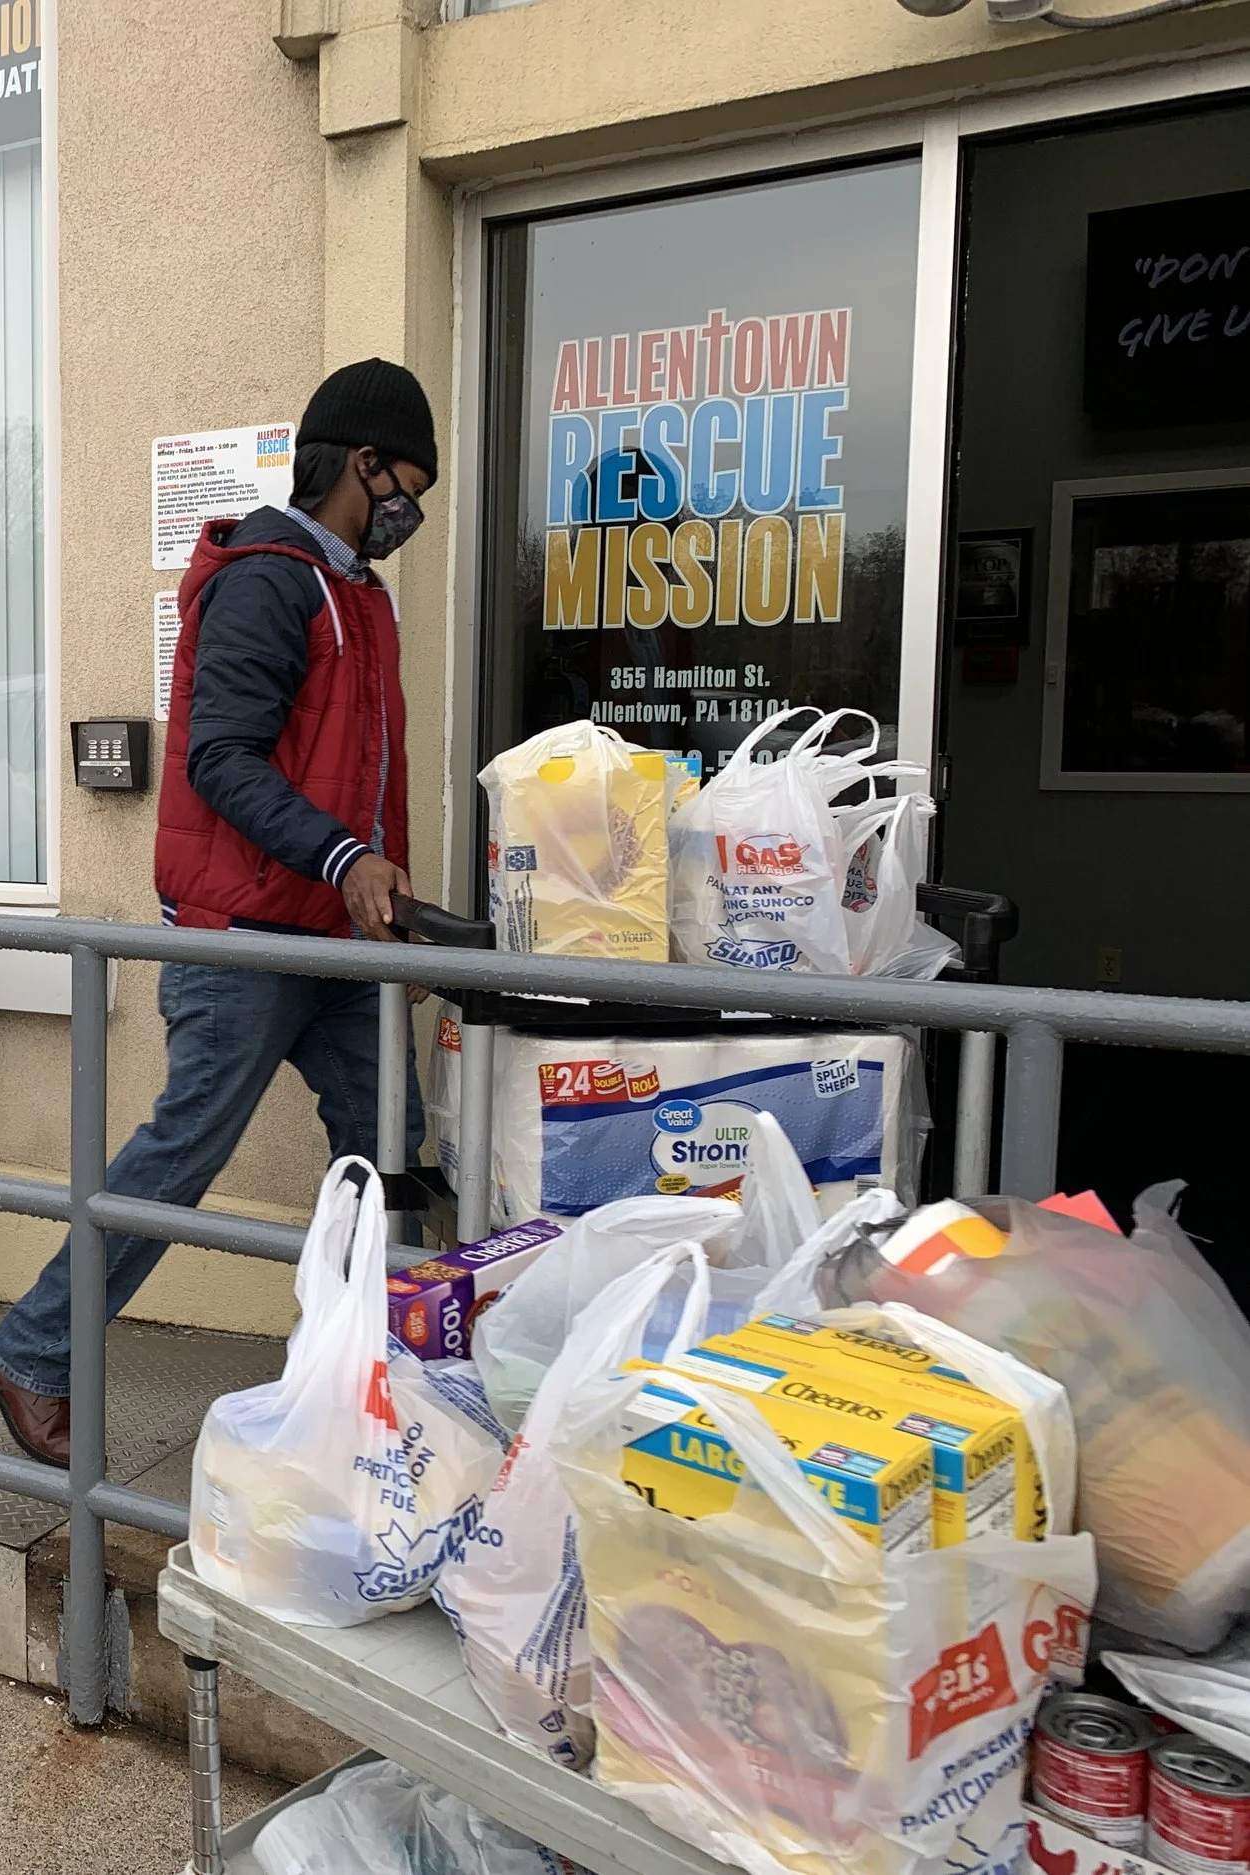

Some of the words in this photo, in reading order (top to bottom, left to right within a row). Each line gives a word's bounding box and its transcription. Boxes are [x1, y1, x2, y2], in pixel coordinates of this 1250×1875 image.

[1118, 308, 1212, 357] GIVE
[257, 438, 290, 454] RESCUE
[546, 388, 849, 526] RESCUE
[257, 453, 289, 468] MISSION
[543, 513, 846, 631] MISSION
[610, 667, 646, 689] 355
[654, 666, 736, 688] Hamilton
[744, 664, 770, 687] St.
[590, 701, 687, 726] Allentown,
[696, 701, 719, 722] PA
[736, 842, 802, 868] GAS
[737, 864, 804, 876] REWARDS
[752, 896, 814, 908] SUNOCO
[753, 886, 782, 895] ANY
[728, 911, 785, 924] OCATION
[622, 931, 652, 943] Yours
[541, 1066, 555, 1079] 12
[557, 1066, 590, 1097] 24
[594, 1074, 622, 1087] DOUBLE
[816, 1065, 845, 1081] SPLIT
[818, 1073, 855, 1093] SHEETS
[659, 1108, 693, 1119] Great
[460, 1235, 542, 1262] Cheerios
[831, 1330, 931, 1363] Cheerios
[782, 1381, 889, 1422] Cheerios
[670, 1431, 746, 1477] LARG
[807, 1475, 846, 1510] ZE
[380, 1488, 416, 1514] FUE
[1023, 1605, 1091, 1673] GA
